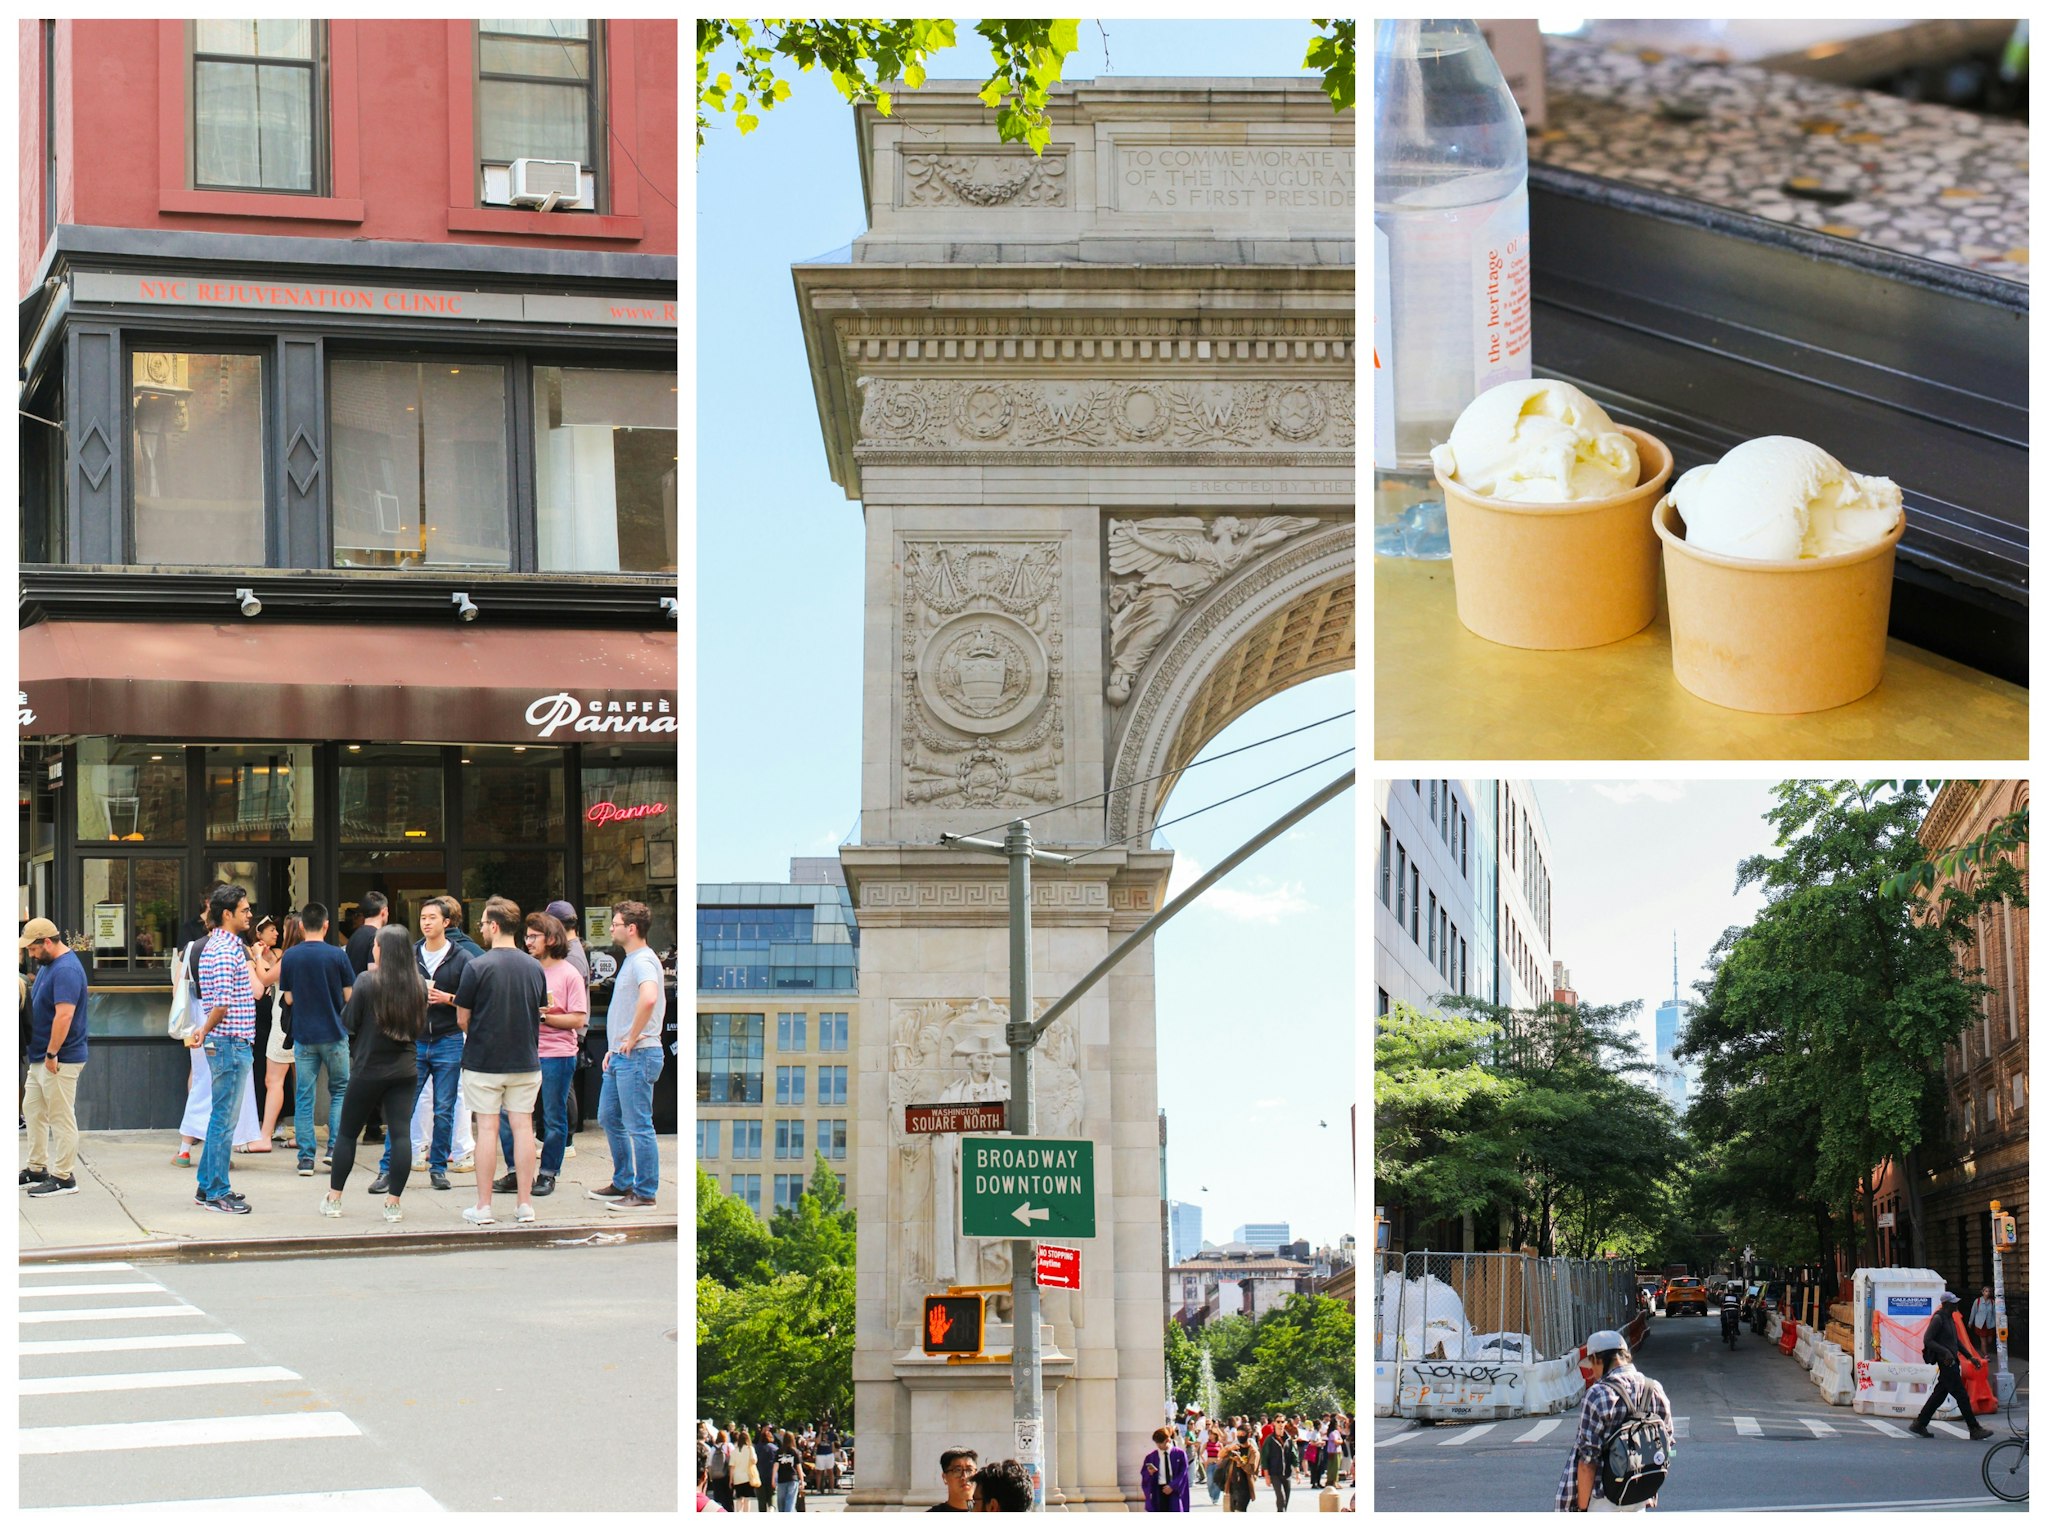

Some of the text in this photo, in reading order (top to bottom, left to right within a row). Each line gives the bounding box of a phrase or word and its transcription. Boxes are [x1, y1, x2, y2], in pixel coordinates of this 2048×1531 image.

[1122, 150, 1153, 167] TO
[1158, 150, 1335, 167] COMMEMORATE
[1125, 170, 1355, 188] OF THE INAUGURAT
[1146, 189, 1355, 207] AS FIRST PRESIDE
[139, 279, 462, 314] NYC REJUVENATION CLINIC
[609, 303, 677, 321] www.R
[1487, 249, 1503, 363] the heritage
[1189, 481, 1272, 492] ERECTED
[1279, 481, 1299, 492] BY
[1309, 481, 1344, 492] THE
[525, 692, 677, 737] Panna
[588, 698, 670, 713] CAFFÈ
[588, 801, 668, 828] Panna
[931, 1107, 980, 1117] WASHINGTON
[912, 1113, 1000, 1132] SQUARE NORTH
[977, 1149, 1078, 1169] BROADWAY
[976, 1175, 1082, 1195] DOWNTOWN
[1039, 1249, 1074, 1261] NO STOPPING
[1039, 1258, 1062, 1268] Anytime
